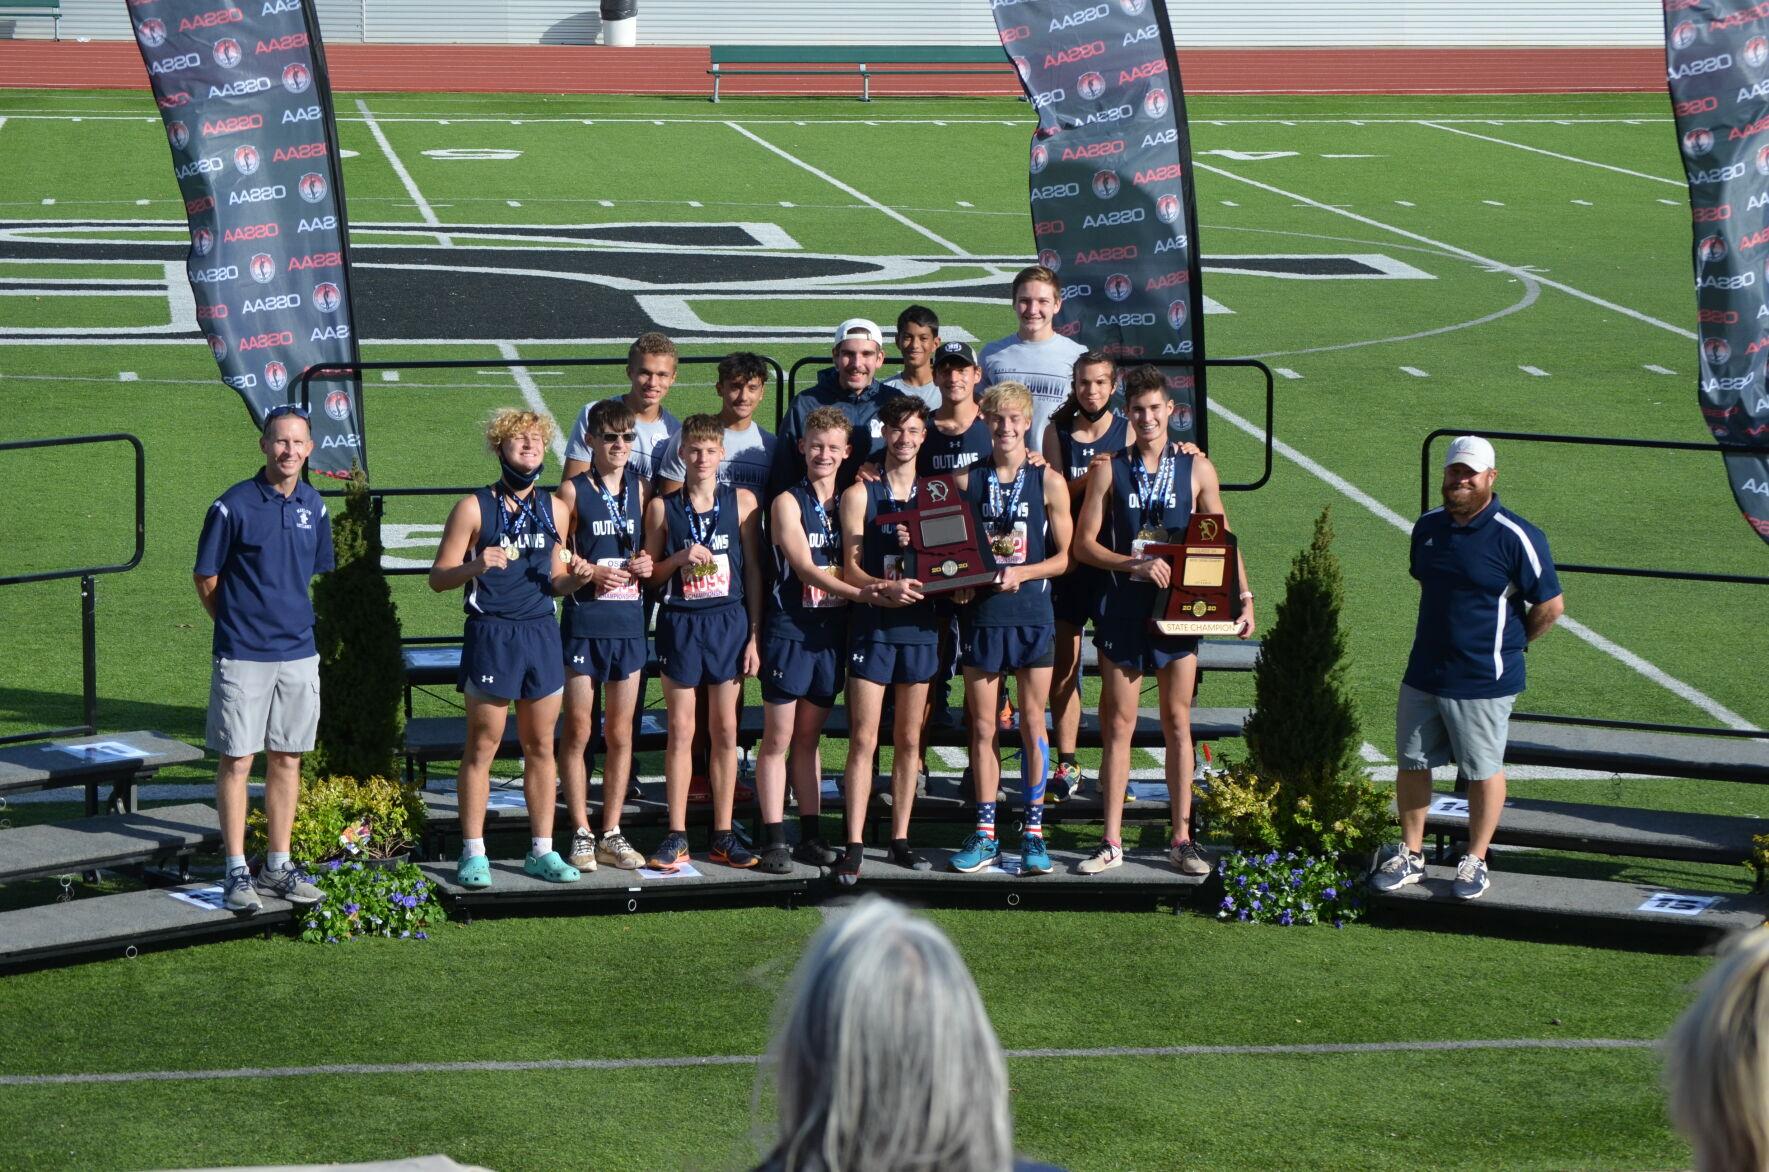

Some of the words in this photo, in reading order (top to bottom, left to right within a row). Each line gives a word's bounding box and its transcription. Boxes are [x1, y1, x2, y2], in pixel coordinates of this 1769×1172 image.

[592, 519, 635, 536] OUTLS
[1166, 623, 1189, 632] STATE
[1190, 623, 1235, 632] CHAMPION
